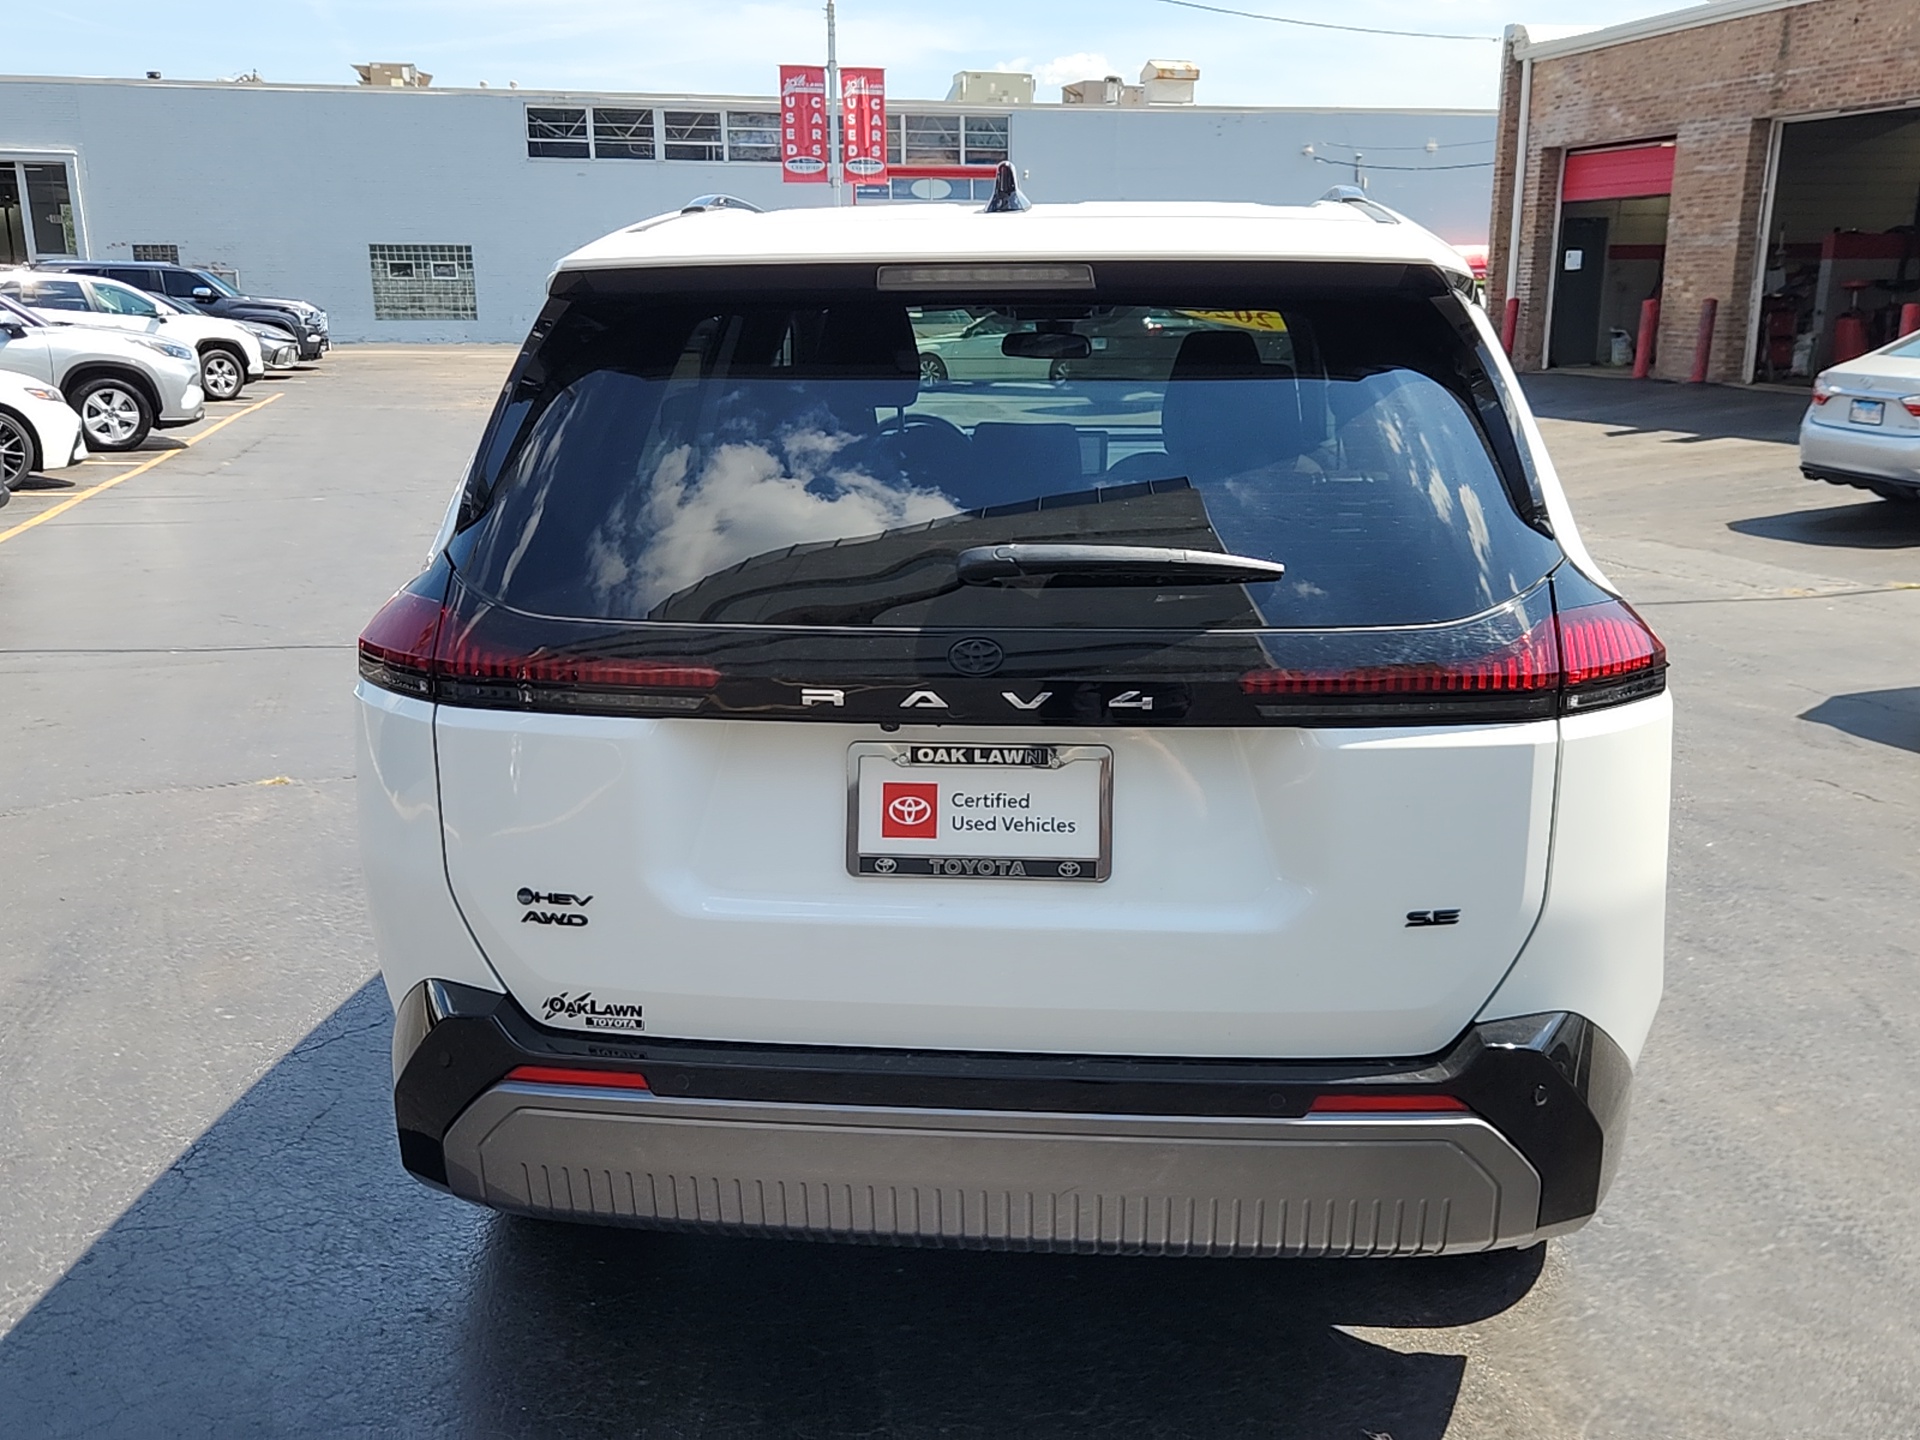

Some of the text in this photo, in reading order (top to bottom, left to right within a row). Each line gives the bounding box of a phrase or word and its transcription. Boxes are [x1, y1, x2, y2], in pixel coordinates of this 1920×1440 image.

[785, 97, 797, 156] USED
[810, 97, 822, 156] CARS
[847, 97, 858, 157] USED
[871, 98, 882, 157] CARS
[801, 688, 1154, 710] RAV4
[917, 748, 1042, 765] OAK LAWN
[951, 793, 1031, 809] Certified
[951, 816, 1077, 834] Used Vehicles
[929, 858, 1027, 877] TOYOTA
[534, 891, 594, 907] HEV
[521, 910, 589, 927] AWD
[1404, 908, 1462, 928] SE
[592, 1017, 637, 1029] TOYOTA
